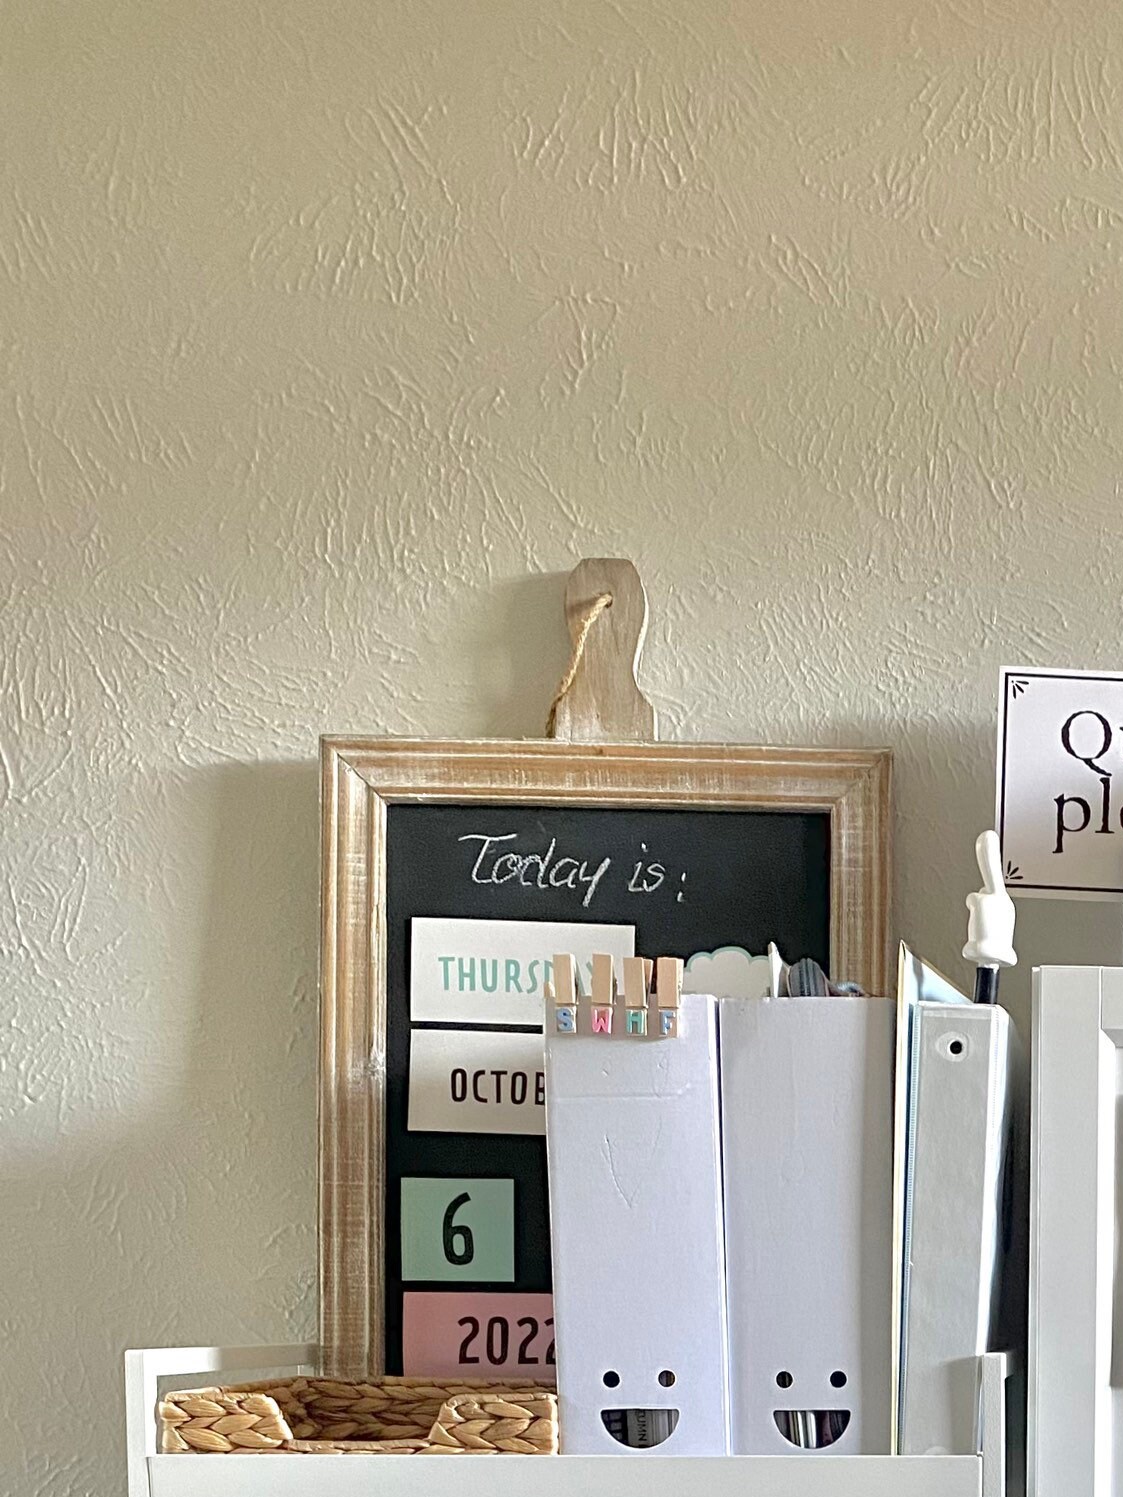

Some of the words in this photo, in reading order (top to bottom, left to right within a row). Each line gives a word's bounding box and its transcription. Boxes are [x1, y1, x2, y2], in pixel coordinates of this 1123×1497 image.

[457, 834, 611, 907] Today
[438, 956, 594, 995] THURS
[556, 1007, 574, 1032] S
[591, 1008, 611, 1034] W
[661, 1010, 675, 1035] F
[451, 1068, 546, 1106] OCTOB
[443, 1191, 475, 1266] 6
